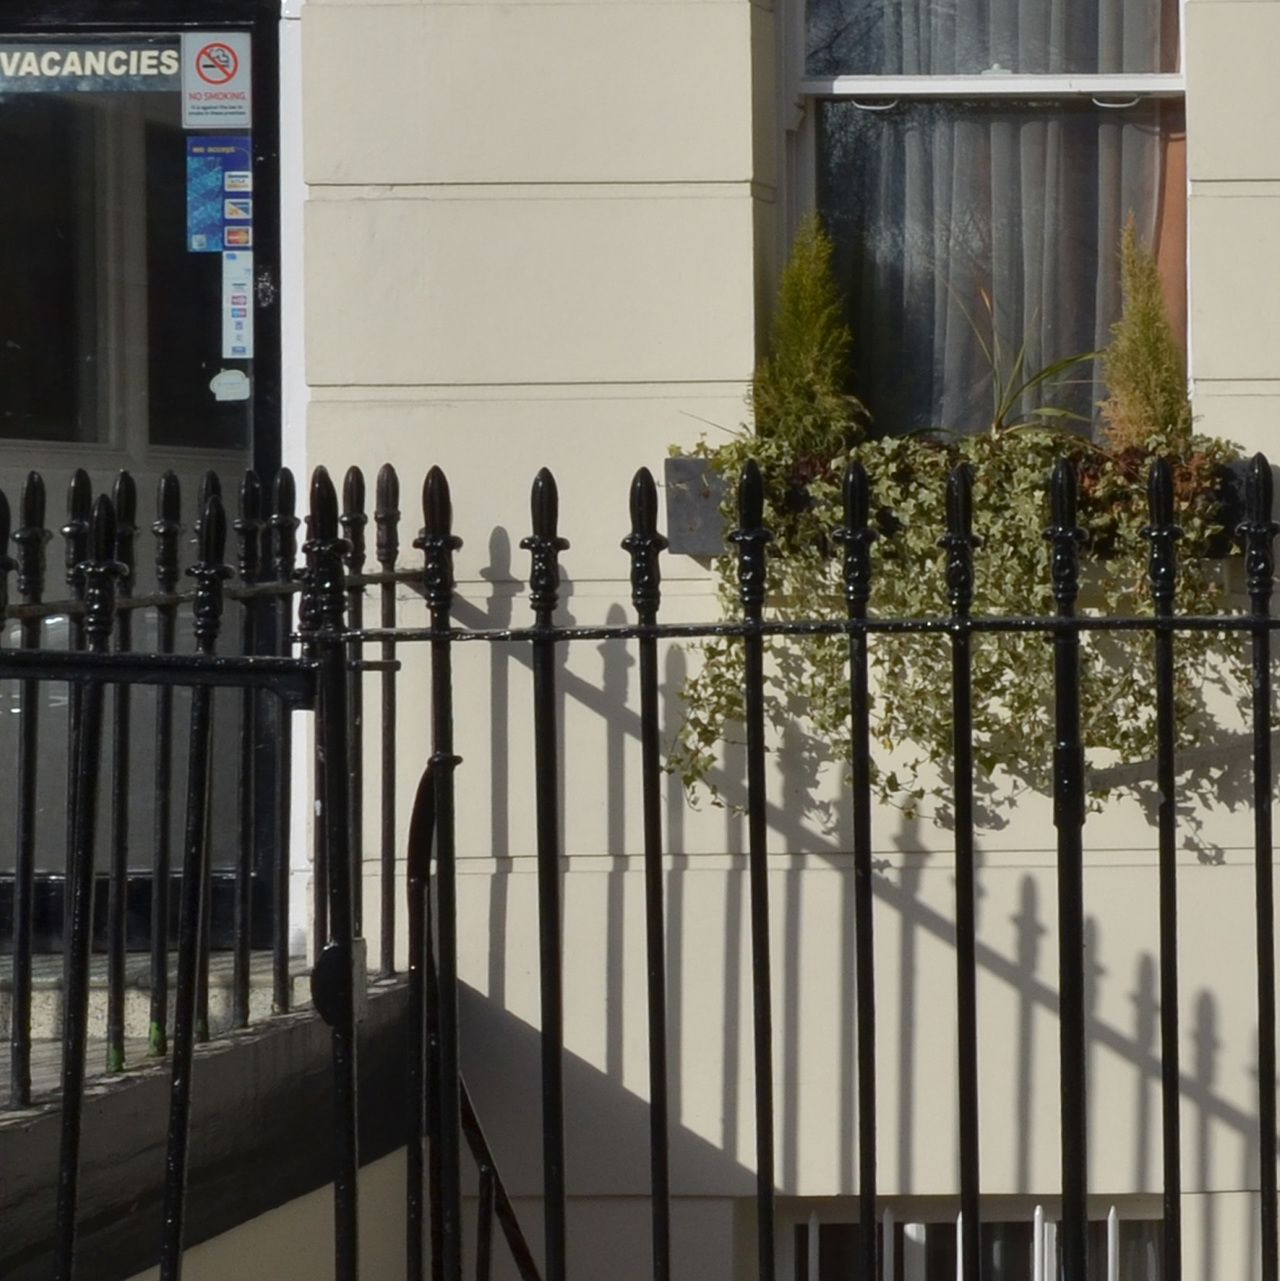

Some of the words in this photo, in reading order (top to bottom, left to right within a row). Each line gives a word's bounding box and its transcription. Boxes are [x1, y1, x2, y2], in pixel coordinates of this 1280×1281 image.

[0, 49, 180, 76] VACANCIES
[188, 91, 202, 101] NO
[204, 91, 246, 101] SMOKING
